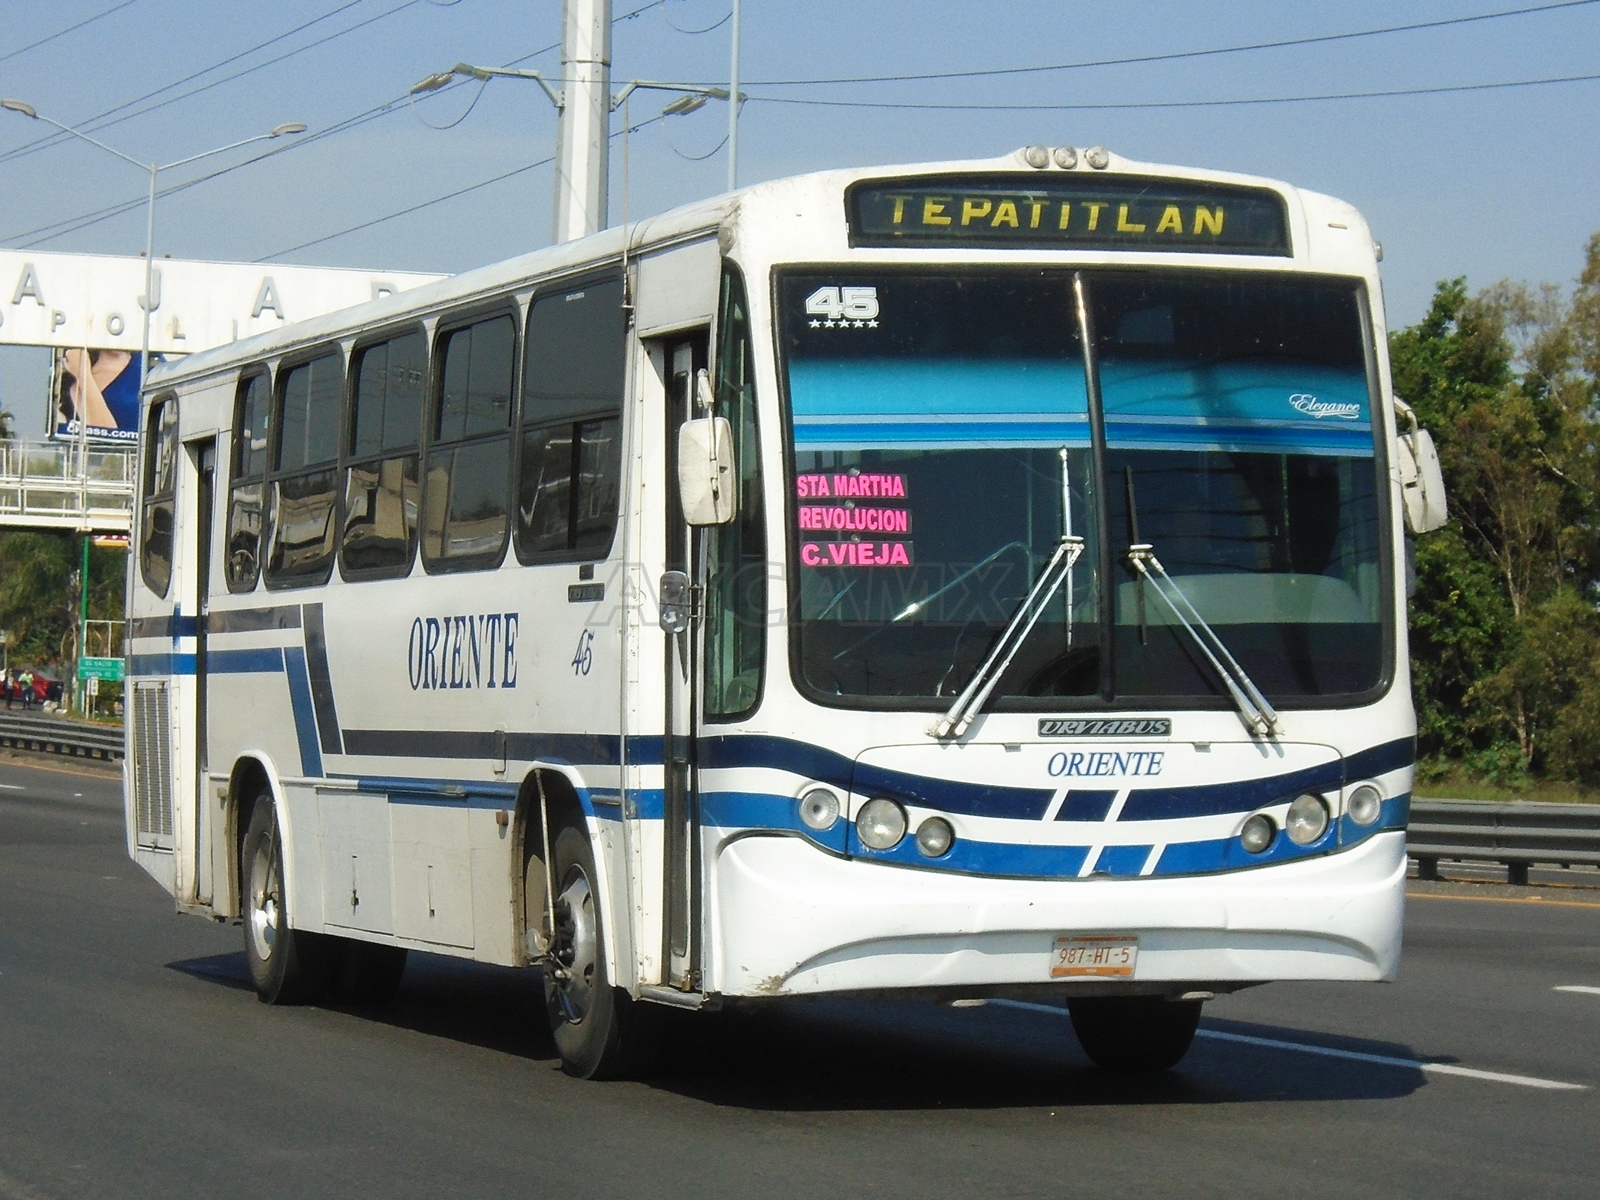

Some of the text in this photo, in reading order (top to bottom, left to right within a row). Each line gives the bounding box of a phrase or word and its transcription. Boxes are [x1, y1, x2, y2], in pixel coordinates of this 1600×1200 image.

[885, 194, 1225, 237] TEPATITLAN
[805, 286, 880, 319] 45
[1288, 393, 1361, 419] Elegance
[797, 475, 905, 497] STA MARTHA
[799, 507, 908, 532] REVOLUCION
[801, 543, 910, 566] C.VIEJA
[408, 612, 519, 691] ORIENTE
[571, 628, 594, 676] 45
[1040, 719, 1170, 735] URVIABUS
[1047, 751, 1165, 777] ORIENTE
